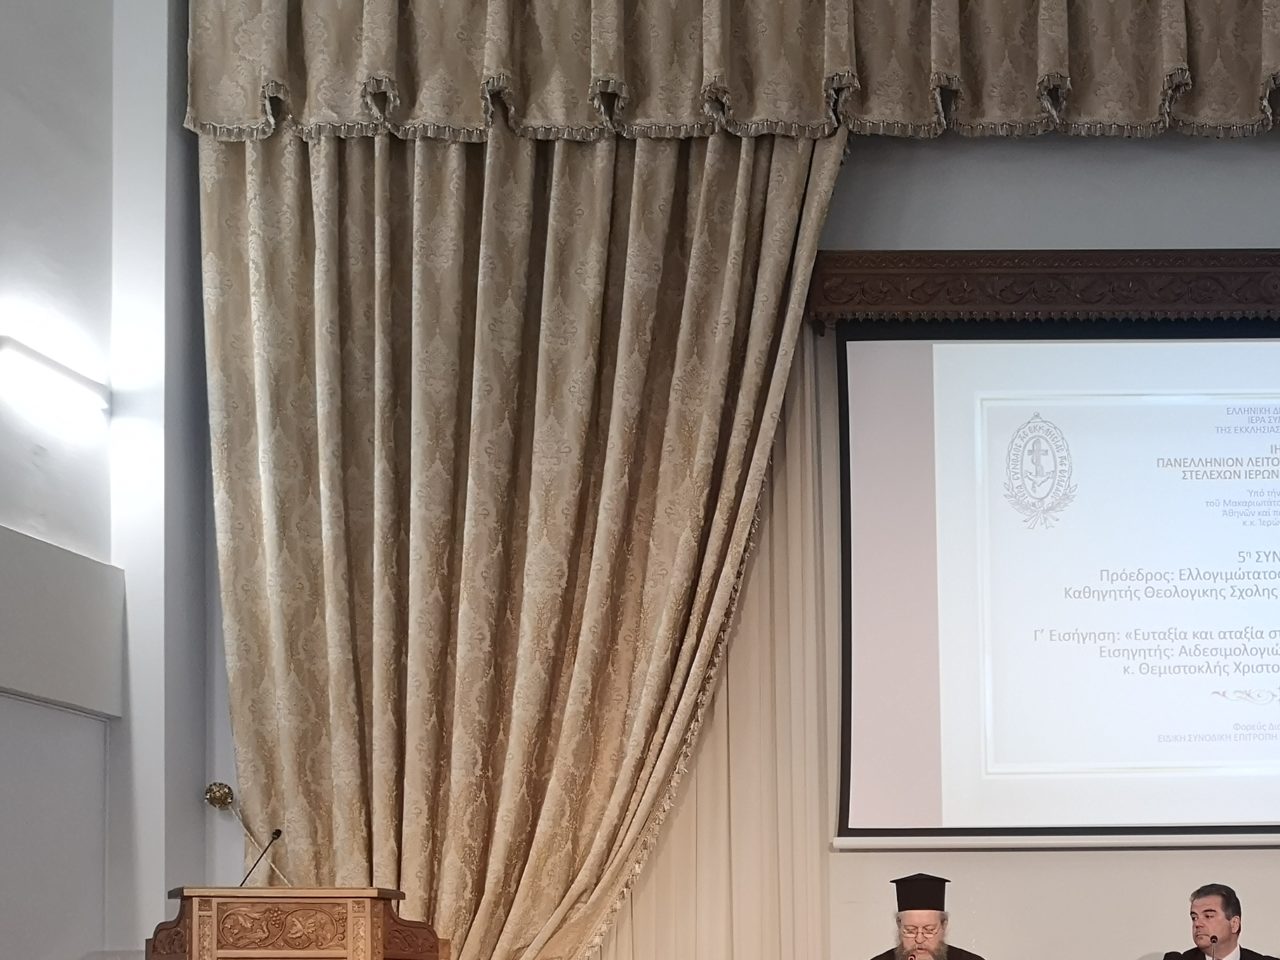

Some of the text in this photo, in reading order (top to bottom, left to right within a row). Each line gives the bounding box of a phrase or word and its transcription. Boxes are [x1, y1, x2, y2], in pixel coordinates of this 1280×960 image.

[1226, 407, 1271, 416] ΕΛΛΗΝΙΚΗ
[1247, 416, 1267, 425] ΙΕΡΑ
[1215, 426, 1232, 434] ΤΗΣ
[1234, 425, 1280, 434] ΕΚΚΛΗΣΙΑΣ
[1156, 457, 1244, 469] ΠΑΝΕΛΛΗΝΙΟΝ
[1182, 469, 1241, 481] ΣΤΕΛΕΧΩΝ
[1244, 469, 1280, 480] ΙΕΡΩΝ
[1100, 568, 1175, 584] Πρόεδρος:
[1064, 586, 1141, 602] Καθηγητής
[1049, 628, 1120, 645] Εισήγηση:
[1125, 627, 1189, 643] «Ευταξία
[1192, 629, 1214, 640] και
[1217, 626, 1265, 642] αταξία
[1099, 644, 1175, 661] Εισηγητής:
[1123, 664, 1135, 675] κ.
[1138, 661, 1230, 677] Θεμιστοκλής
[1233, 732, 1278, 742] ΕΠΙΤΡΟΠΗ
